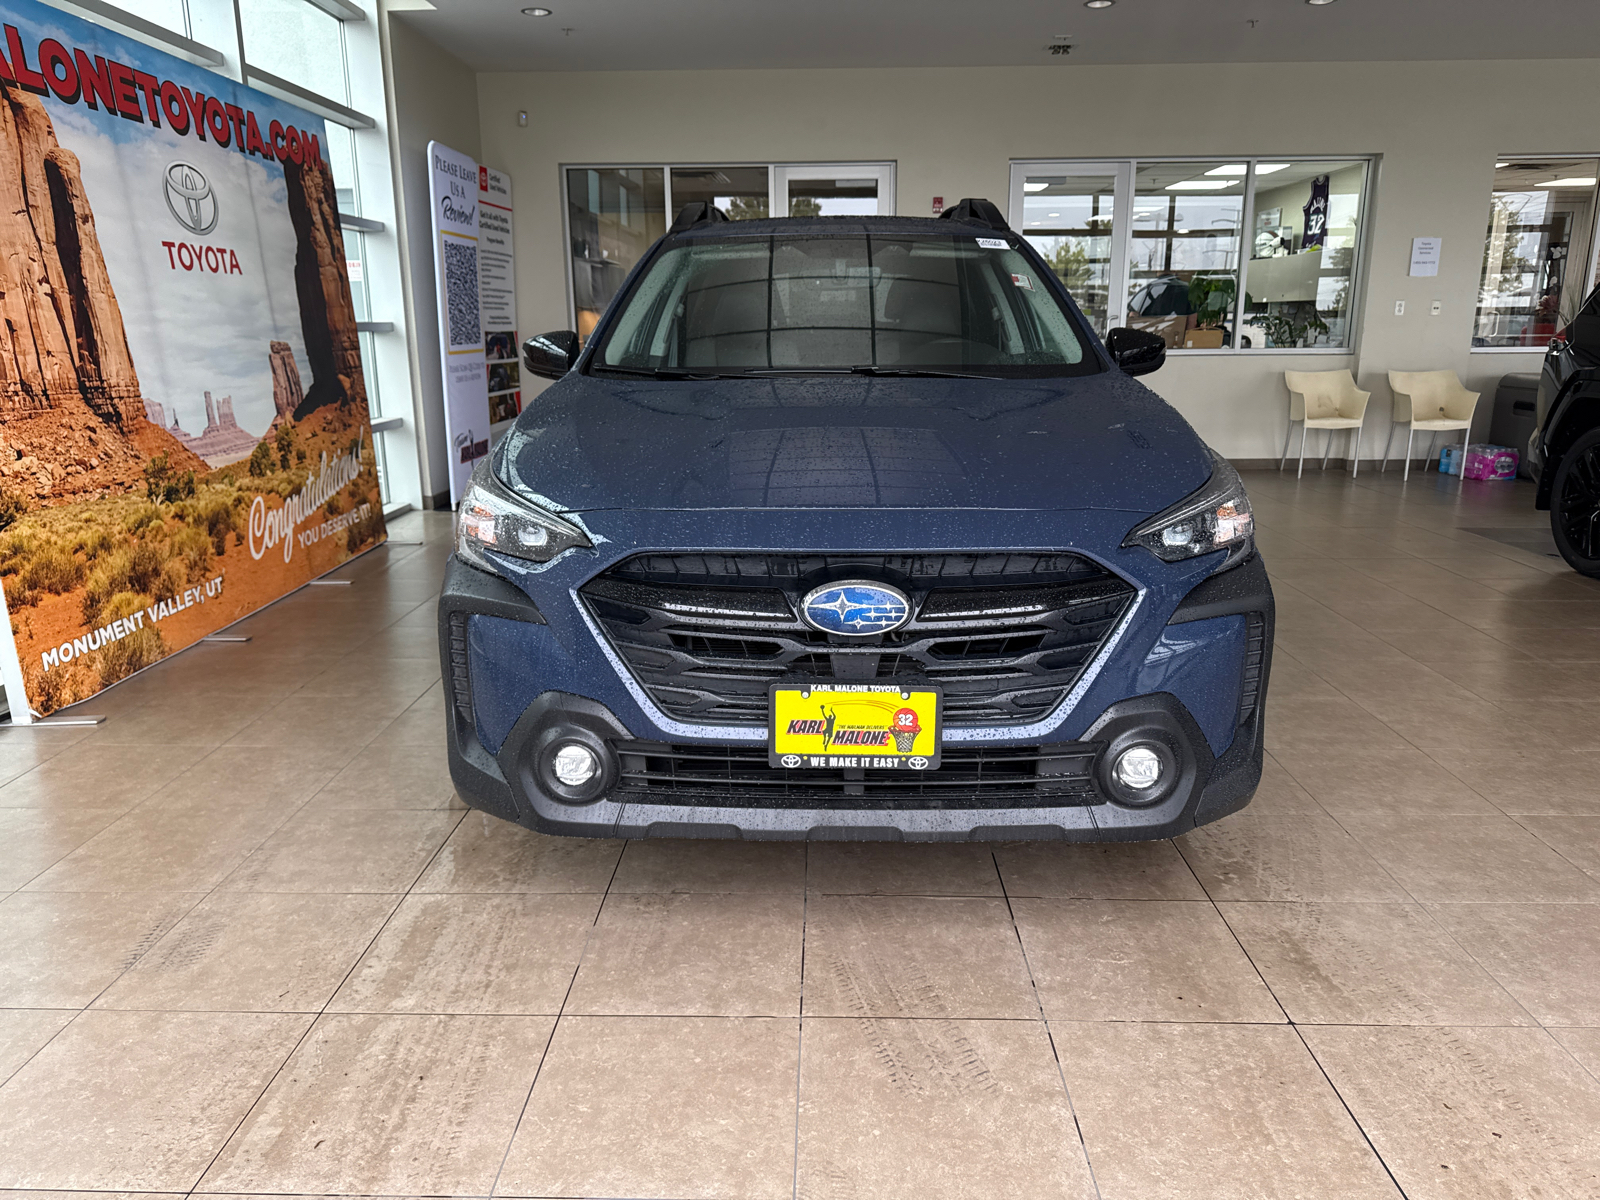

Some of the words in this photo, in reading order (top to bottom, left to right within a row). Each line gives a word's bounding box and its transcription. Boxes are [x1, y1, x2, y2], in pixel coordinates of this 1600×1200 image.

[435, 154, 458, 178] PLEASE
[459, 164, 477, 184] LEAVE
[460, 185, 466, 199] A
[441, 195, 476, 226] Review!
[1307, 214, 1325, 235] 32
[161, 240, 243, 276] TOYOTA
[248, 424, 364, 564] Congratulations!
[298, 526, 319, 549] YOU
[321, 507, 361, 539] DESERVE
[359, 502, 372, 521] IT!
[41, 610, 144, 672] MONUMENT
[147, 585, 205, 624] VALLEY,
[205, 576, 223, 598] UT
[810, 684, 833, 692] KARL
[834, 684, 868, 692] MALONE
[869, 685, 901, 693] TOYOTA
[786, 719, 825, 735] KARL
[898, 713, 914, 726] 32
[832, 730, 890, 746] MALONE
[810, 756, 826, 767] WE
[829, 757, 858, 767] MAKE
[861, 757, 871, 767] IT
[873, 757, 899, 768] EASY
